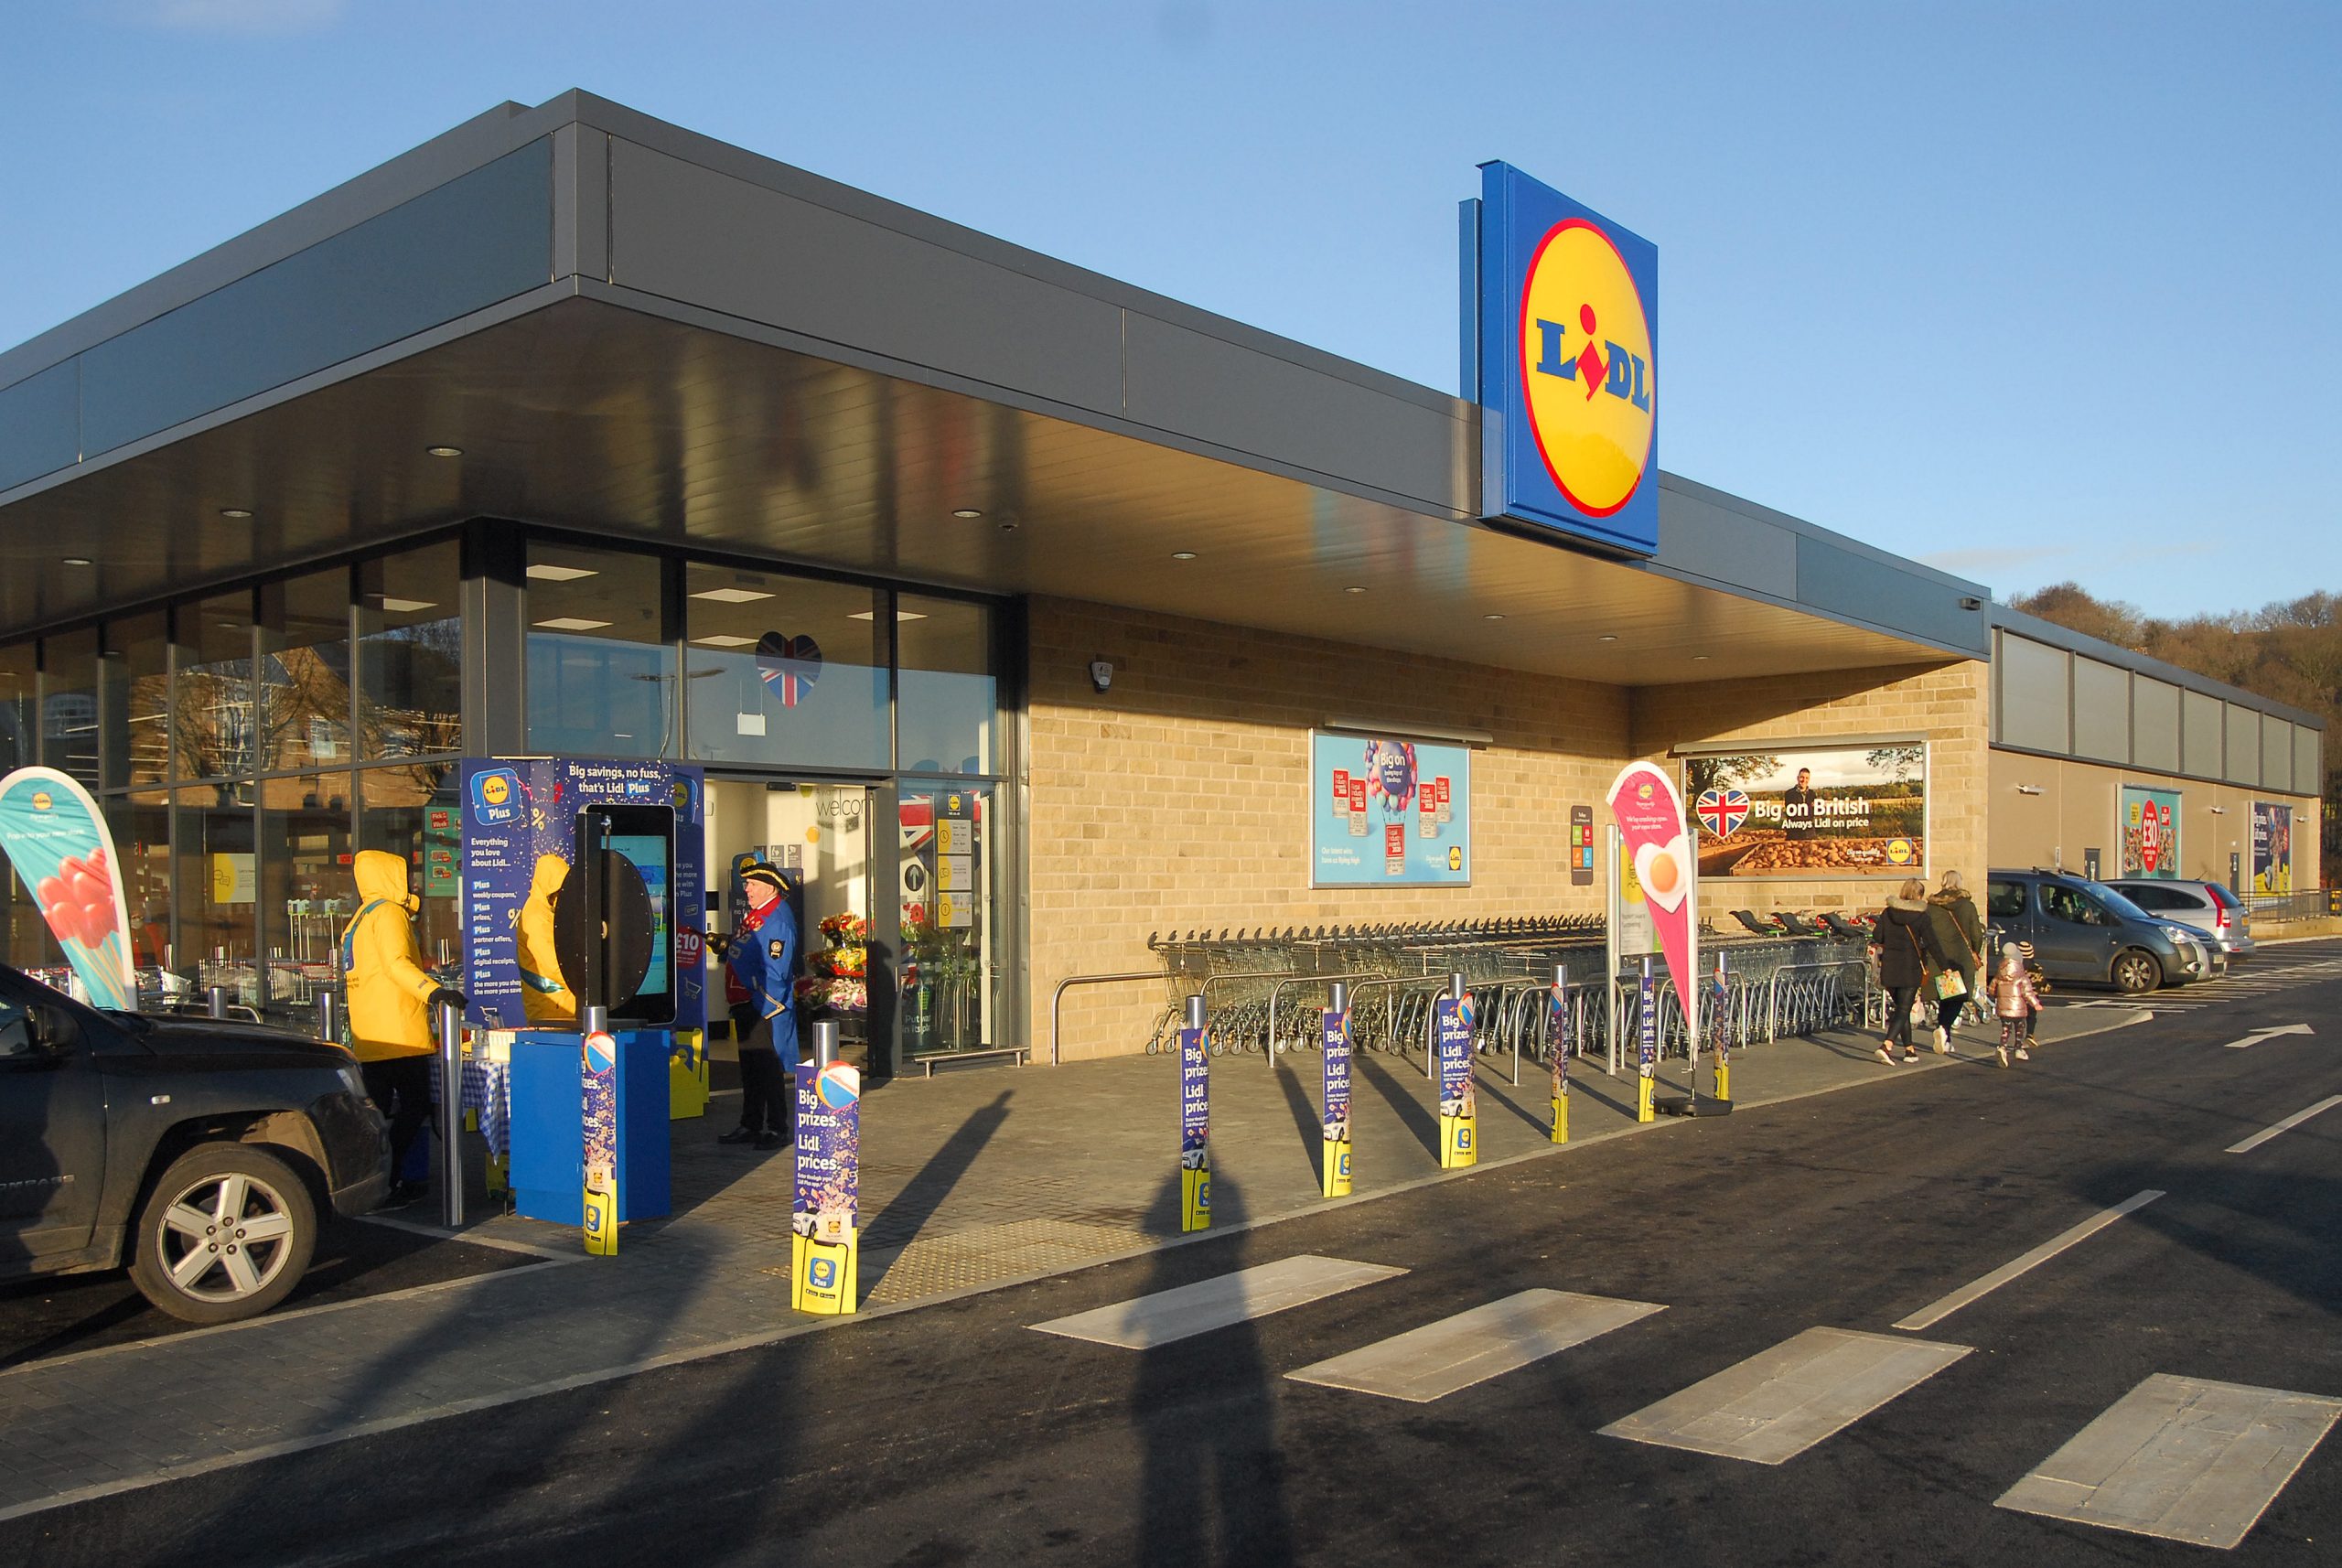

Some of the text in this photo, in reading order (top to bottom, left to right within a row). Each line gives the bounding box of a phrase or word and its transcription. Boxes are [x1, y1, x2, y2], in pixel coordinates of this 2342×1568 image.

[1381, 752, 1405, 769] Big on
[569, 765, 661, 779] Big savings, no fuss,
[578, 782, 650, 793] that's Lidl Plus
[489, 809, 510, 820] Plus
[1755, 797, 1870, 822] Big on British
[1782, 820, 1812, 830] Always
[1815, 818, 1831, 828] Lidl
[1846, 817, 1869, 829] price
[471, 838, 509, 847] Everything
[471, 849, 485, 857] you
[473, 881, 489, 889] Plus
[474, 903, 490, 912] Plus
[474, 926, 490, 934] Plus
[676, 933, 699, 950] £10
[475, 971, 490, 979] Plus
[1442, 1015, 1459, 1028] Big
[1327, 1030, 1343, 1045] Big
[1185, 1047, 1202, 1063] Big
[1443, 1046, 1462, 1058] Lidl
[1185, 1064, 1208, 1081] prize
[1327, 1063, 1345, 1077] Lidl
[1186, 1084, 1204, 1099] Lidl
[798, 1089, 818, 1110] Big
[1186, 1100, 1208, 1116] price
[798, 1111, 841, 1128] prizes.
[798, 1134, 820, 1152] Lidl
[798, 1153, 842, 1171] prices.
